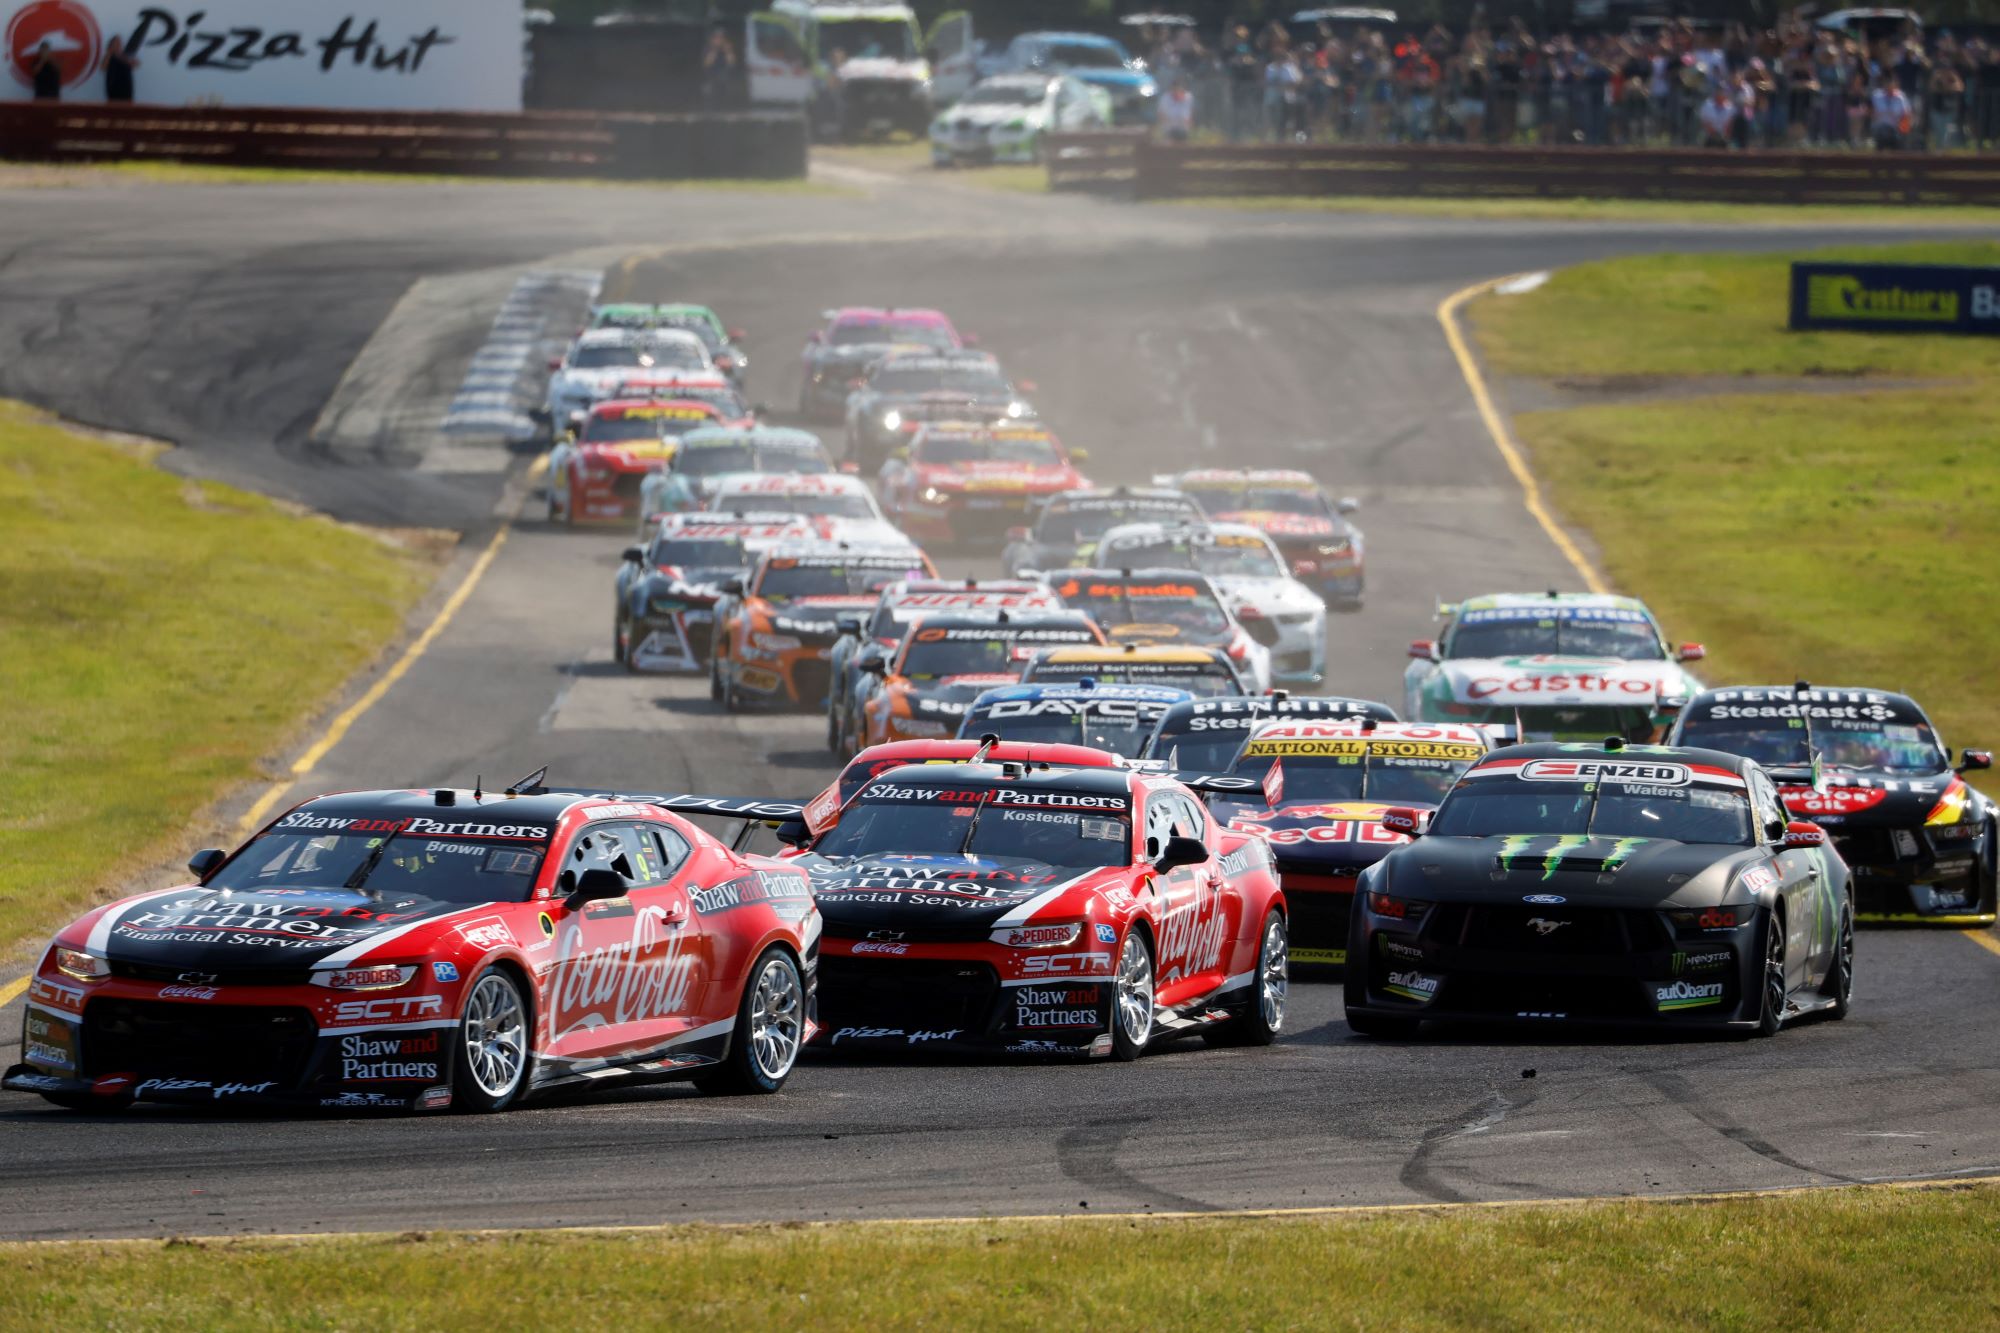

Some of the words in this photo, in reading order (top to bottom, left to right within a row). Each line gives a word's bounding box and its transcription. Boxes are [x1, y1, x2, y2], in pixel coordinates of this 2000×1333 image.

[122, 8, 304, 70] Pizza
[317, 16, 456, 73] Hut
[1714, 690, 1888, 704] PENRITE
[1710, 704, 1858, 719] Steadfast
[1832, 719, 1880, 731] Payne
[1261, 726, 1477, 742] AMPOL
[1251, 741, 1360, 755] NATIONAL
[1371, 743, 1480, 759] STORAGE
[1384, 757, 1451, 770] Feeney
[1578, 763, 1676, 781] ENZED
[1583, 782, 1596, 793] 6
[1623, 784, 1686, 798] Waters
[1804, 801, 1846, 812] OIL
[1002, 810, 1080, 826] Kostecki
[365, 836, 383, 850] 9
[424, 840, 486, 857] Brown
[909, 893, 1025, 909] Services
[1699, 906, 1737, 928] dba
[112, 925, 226, 943] Financial
[231, 931, 356, 948] Services
[1023, 927, 1071, 943] PEDDERS
[1288, 948, 1345, 959] TIONAL
[1686, 951, 1732, 966] MONSTER
[1022, 952, 1111, 972] SCTR
[346, 968, 402, 985] PEDDERS
[335, 995, 443, 1020] SCTR
[1016, 1006, 1097, 1027] Partners
[832, 1026, 904, 1046] Pizza
[907, 1029, 964, 1044] Hut
[342, 1058, 437, 1080] Partners
[135, 1078, 211, 1098] Pizza
[213, 1080, 279, 1098] Hut
